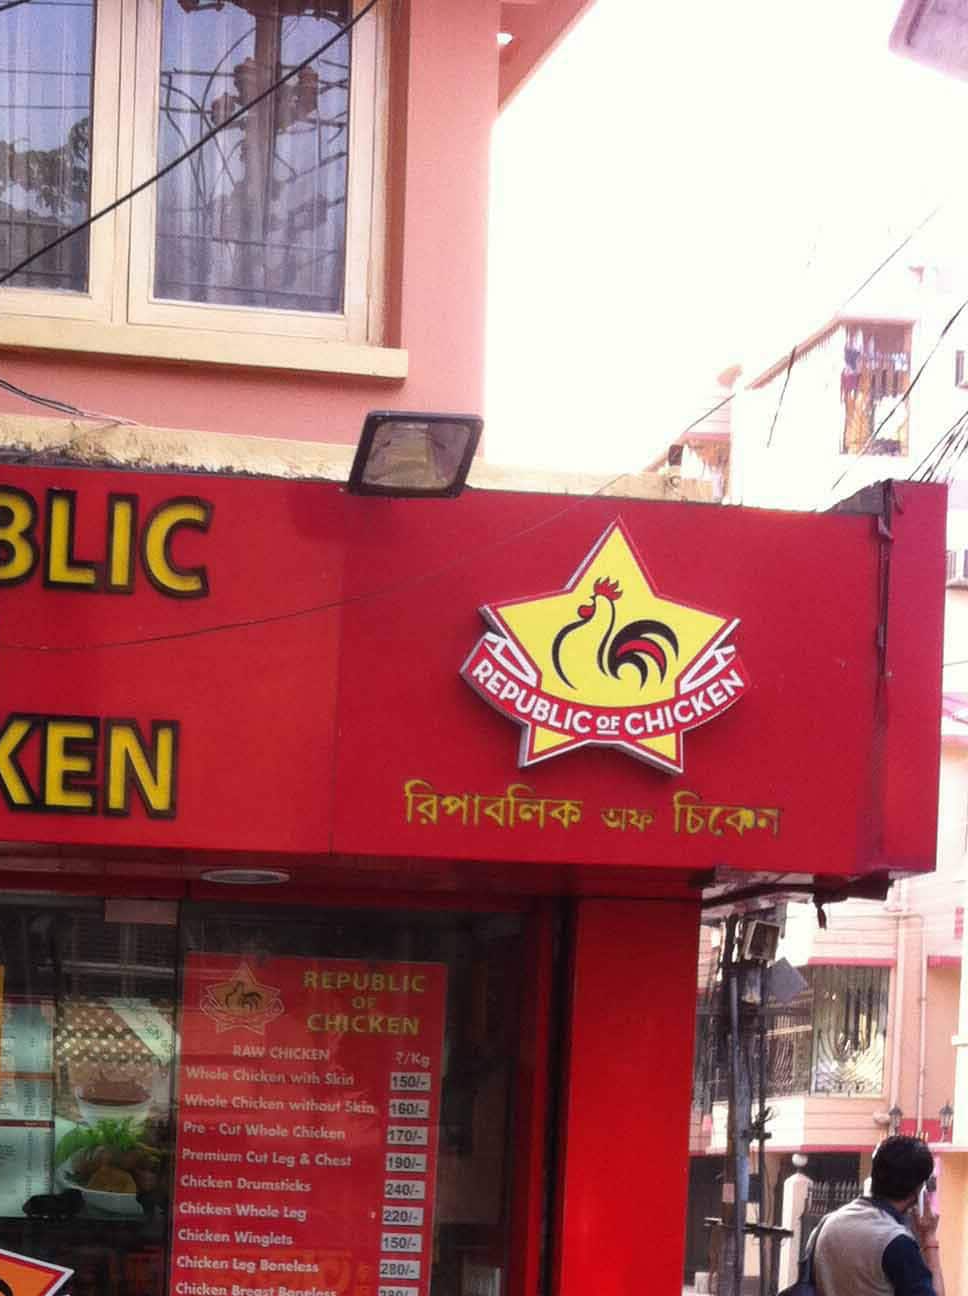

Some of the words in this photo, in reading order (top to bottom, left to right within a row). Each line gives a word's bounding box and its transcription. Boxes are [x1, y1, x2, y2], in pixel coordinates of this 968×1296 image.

[470, 657, 594, 735] REPUBLIC
[596, 714, 620, 735] OF
[623, 668, 746, 736] CHICKEN
[403, 778, 584, 831] রিপাবলিক
[600, 807, 656, 832] অফ
[672, 790, 784, 836] চিকেন
[303, 970, 426, 993] REPUBLIC
[351, 996, 378, 1010] OF
[306, 1013, 421, 1036] CHICKEN
[232, 1044, 263, 1058] RAW
[269, 1046, 331, 1062] CHICKEN
[185, 1066, 228, 1081] Whole
[233, 1068, 285, 1083] Chicken
[291, 1071, 321, 1085] with
[325, 1072, 354, 1087] Skin
[392, 1075, 428, 1089] 150/-
[184, 1093, 228, 1109] Whole
[232, 1095, 284, 1111] Chicken
[289, 1099, 341, 1113] without
[345, 1101, 375, 1115] Skin
[183, 1121, 205, 1135] Pre
[219, 1122, 241, 1136] Cut
[245, 1124, 288, 1138] Whole
[292, 1126, 346, 1141] Chicken
[388, 1128, 423, 1142] 170/-
[182, 1148, 242, 1163] Premium
[246, 1151, 268, 1165] Cut
[272, 1153, 295, 1168] Leg
[315, 1153, 352, 1168] Chest
[387, 1155, 422, 1169] 190/-
[180, 1174, 232, 1189] Chicken
[237, 1177, 312, 1193] Drumsticks
[385, 1182, 420, 1196] 240/-
[179, 1202, 232, 1217] Chicken
[236, 1204, 280, 1218] Whole
[284, 1206, 307, 1222] Leg
[384, 1209, 418, 1223] 220/-
[178, 1229, 231, 1243] Chicken
[234, 1231, 293, 1247] Winglets
[383, 1236, 417, 1249] 150/-
[177, 1256, 229, 1270] Chicken
[233, 1258, 256, 1273] Leg
[260, 1260, 319, 1274] Boneless
[175, 1283, 228, 1296] Chicken
